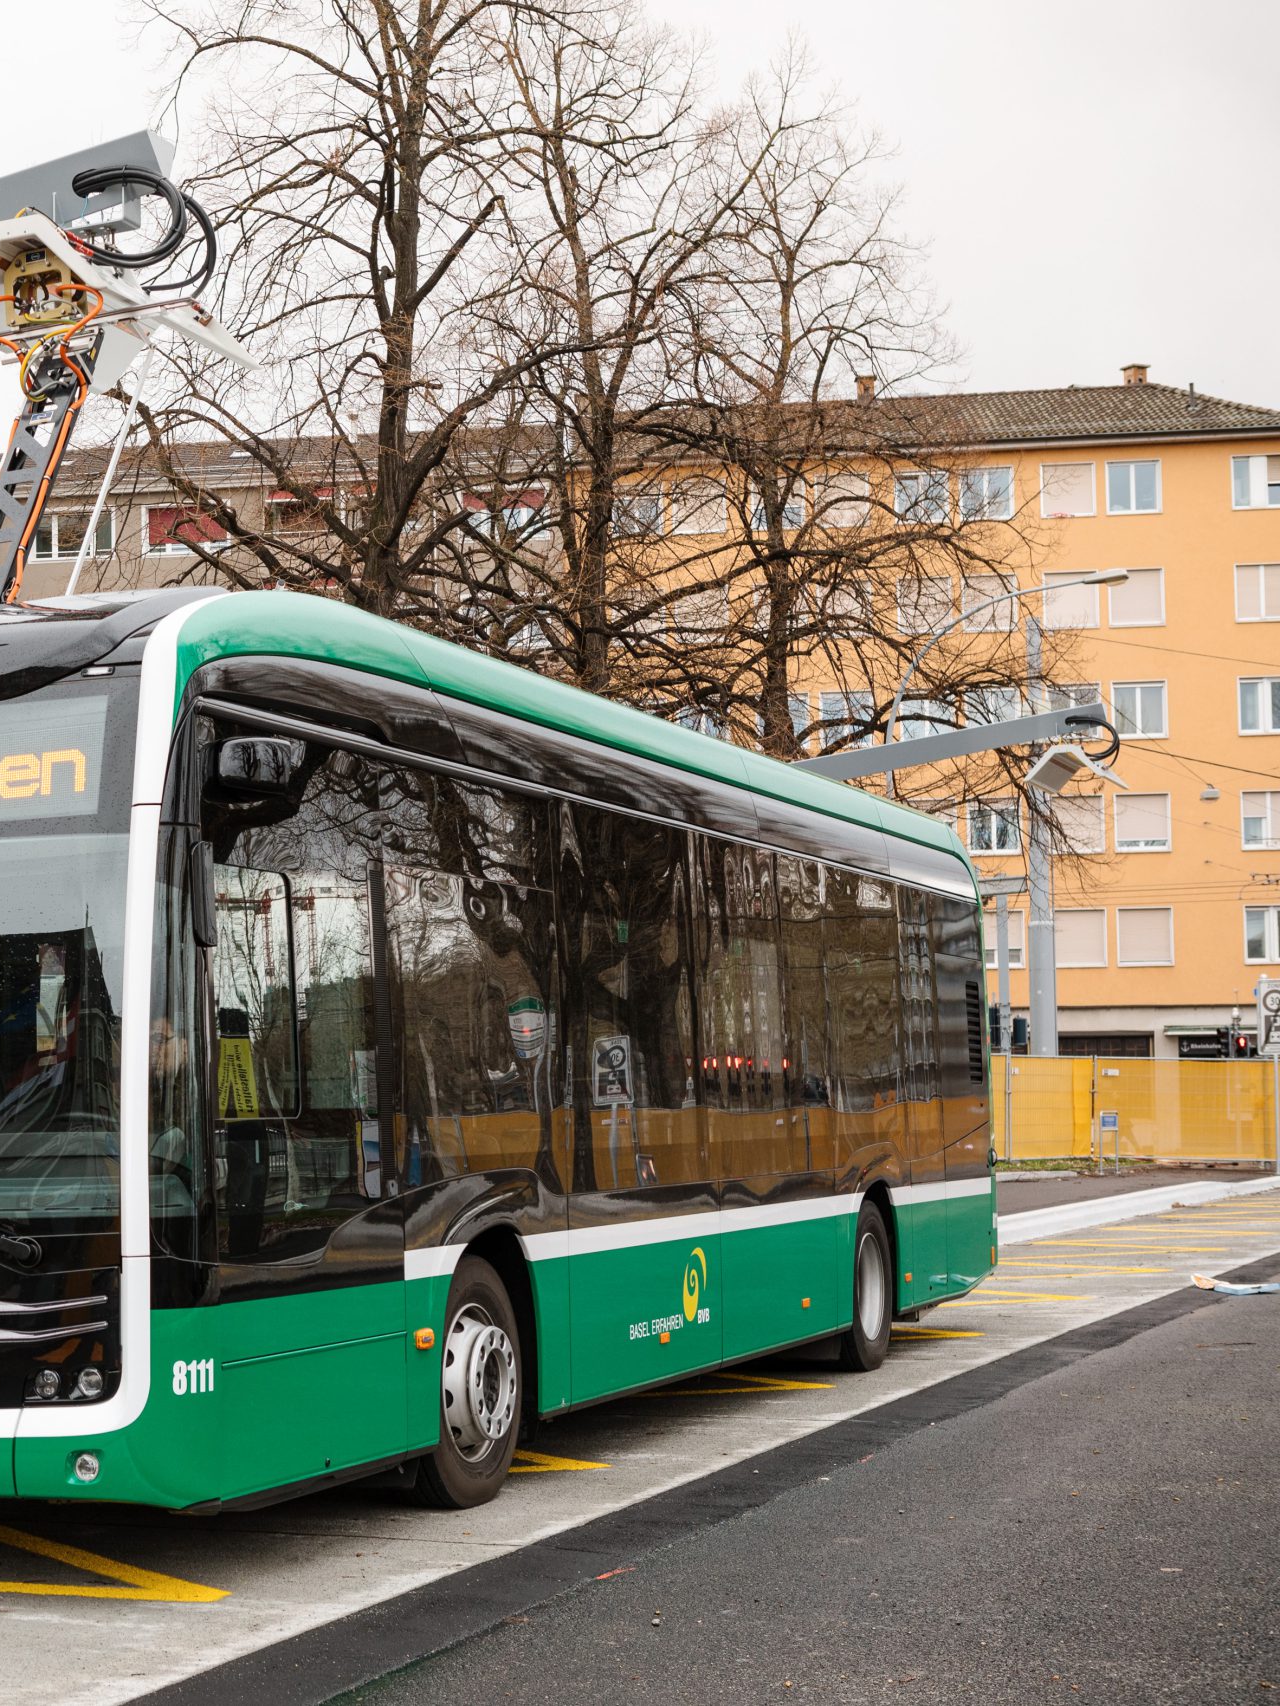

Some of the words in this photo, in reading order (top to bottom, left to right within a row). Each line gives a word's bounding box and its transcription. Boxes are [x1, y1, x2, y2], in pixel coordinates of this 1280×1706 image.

[629, 1321, 650, 1340] BASEL
[651, 1313, 684, 1335] ERFAHREN
[697, 1308, 710, 1324] BVB
[172, 1357, 214, 1395] 8111
